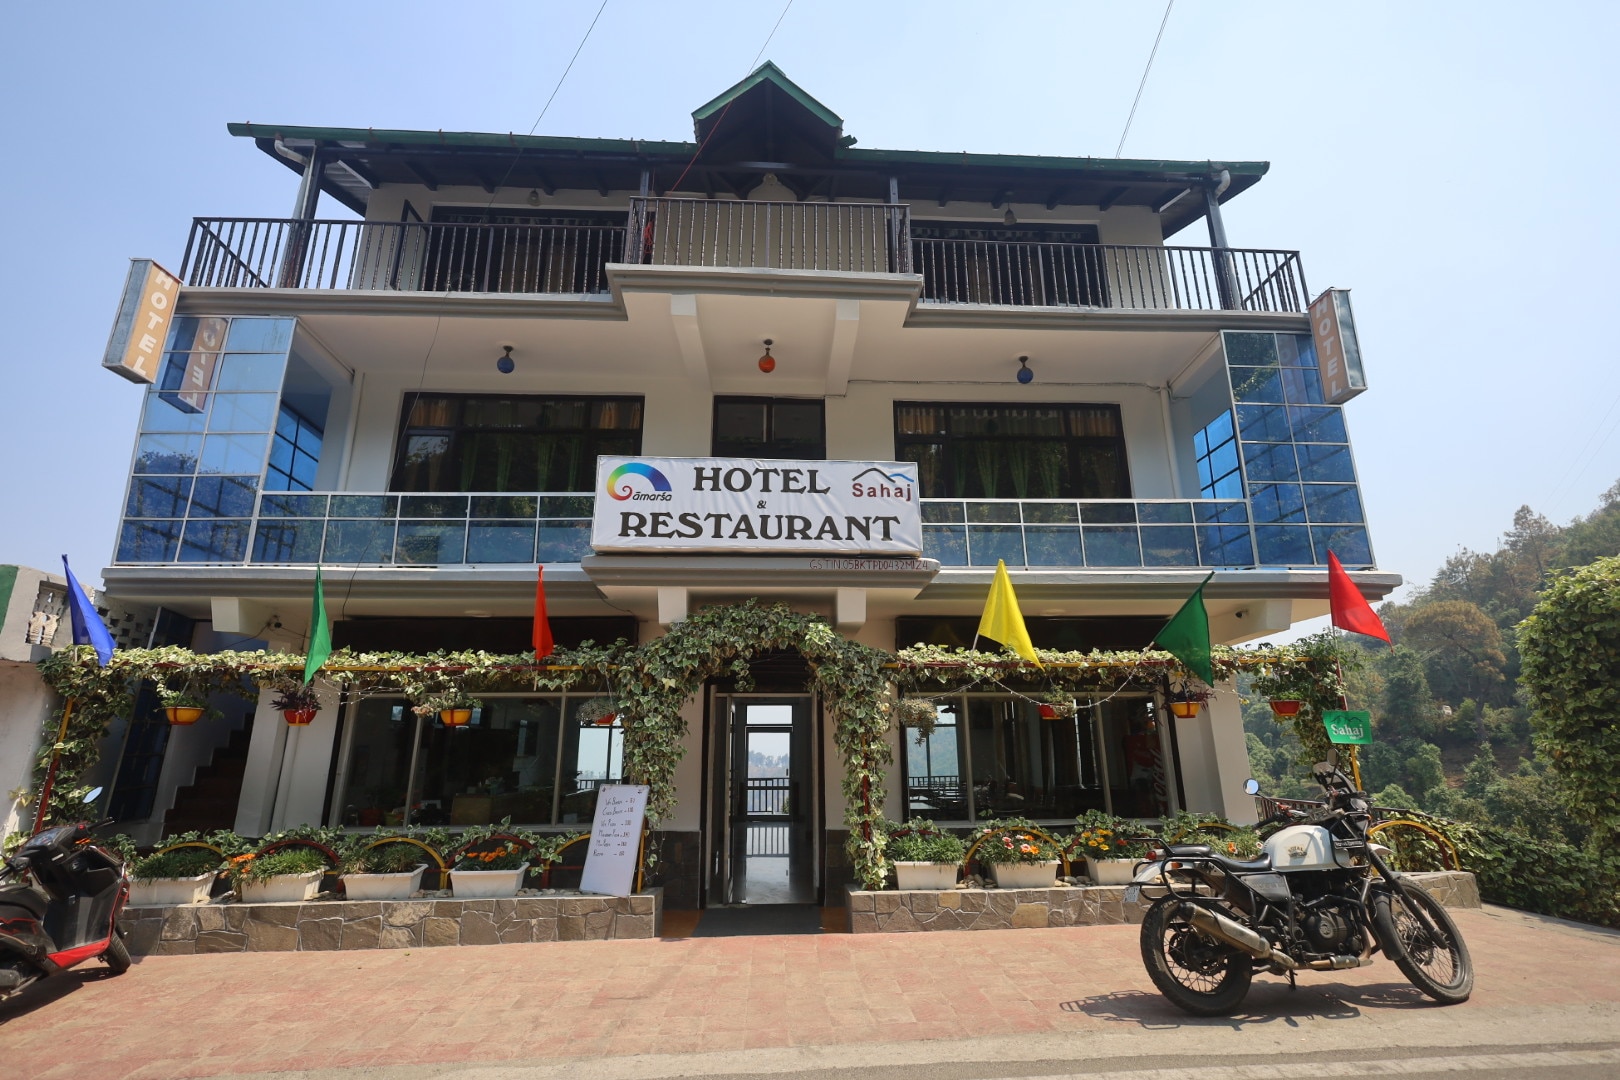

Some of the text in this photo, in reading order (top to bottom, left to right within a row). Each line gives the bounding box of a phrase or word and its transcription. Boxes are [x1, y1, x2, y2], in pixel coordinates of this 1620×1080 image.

[132, 270, 174, 377] HOTEL
[1315, 297, 1342, 397] HOTEL
[692, 466, 831, 495] HOTEL
[852, 482, 912, 502] Sahaj
[756, 499, 767, 510] &
[617, 510, 901, 542] RESTAURANT
[1330, 723, 1364, 738] Sahaj
